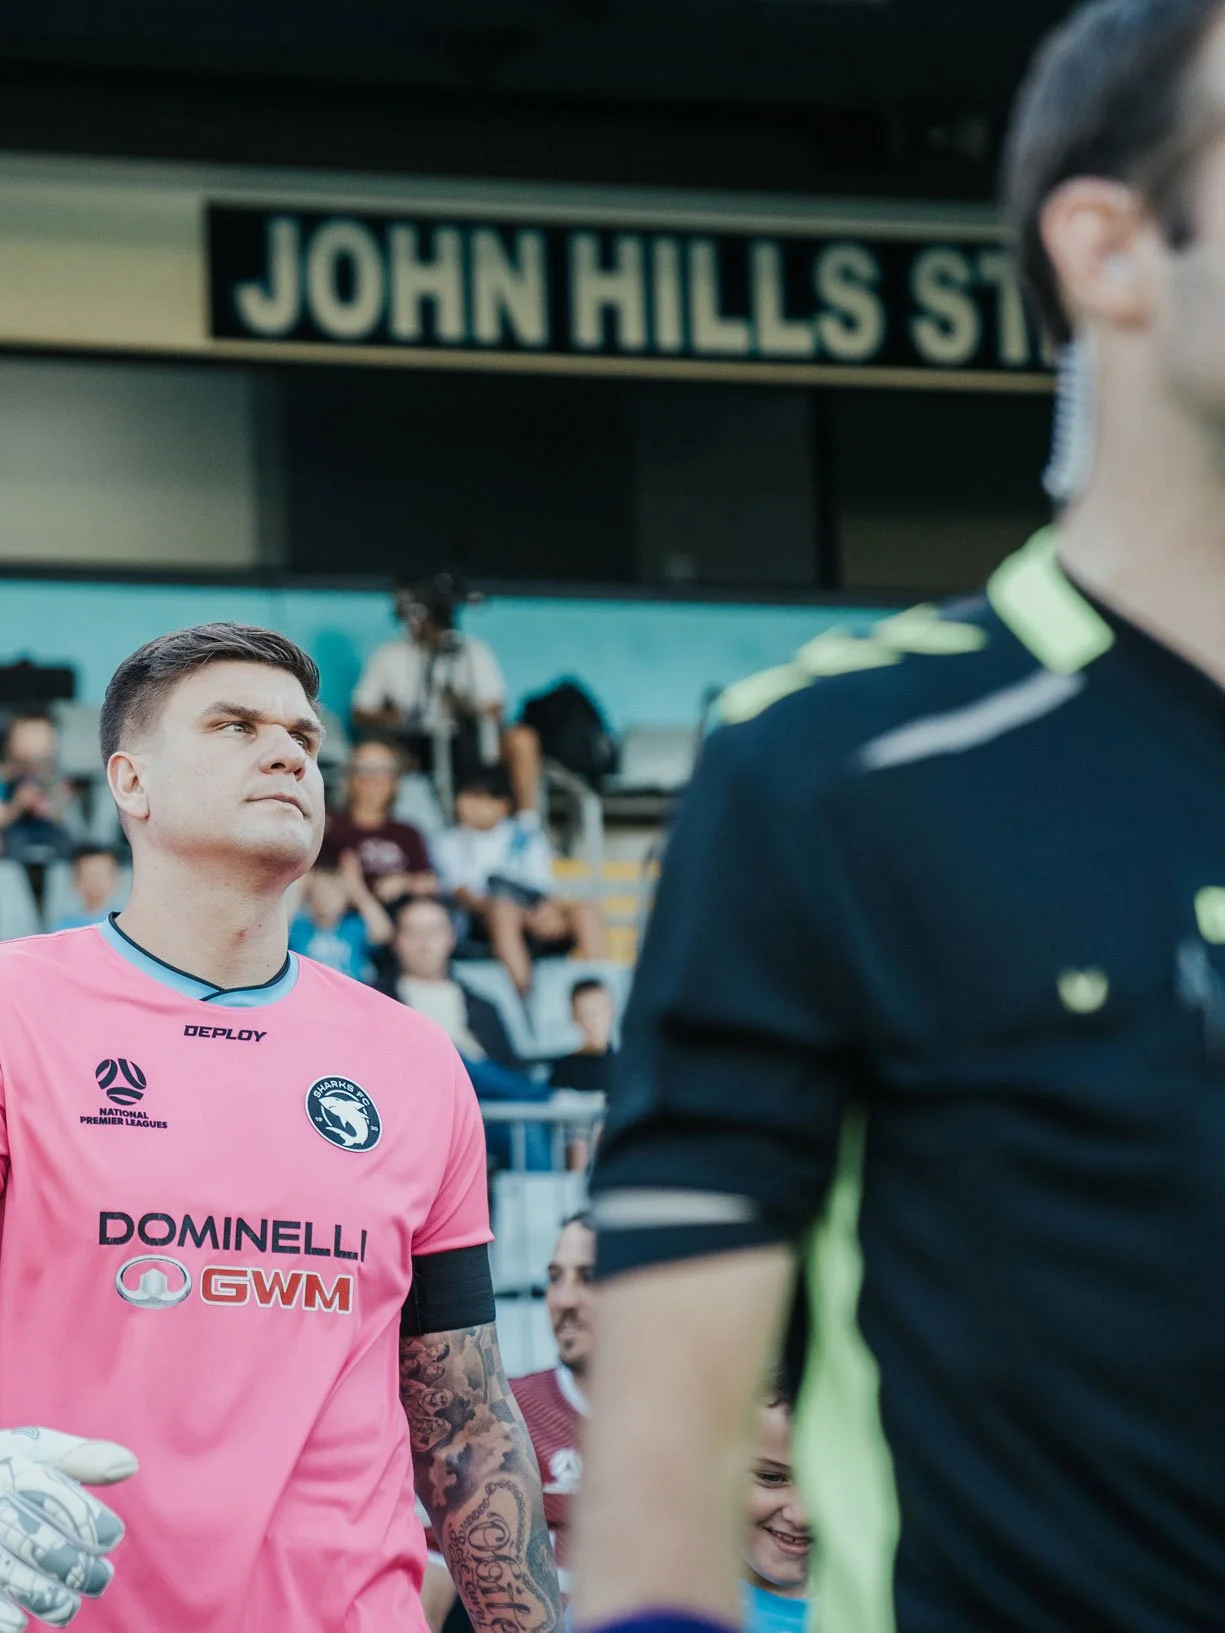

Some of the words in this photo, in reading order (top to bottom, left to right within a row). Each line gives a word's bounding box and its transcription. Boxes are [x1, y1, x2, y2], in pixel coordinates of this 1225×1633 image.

[235, 216, 547, 344] JOHN
[572, 235, 883, 360] HILLS
[911, 250, 1054, 367] ST
[184, 1025, 267, 1042] DEPLOY
[313, 1080, 354, 1098] SHARKS
[356, 1091, 371, 1107] FC
[80, 1116, 124, 1126] PREMIER
[126, 1118, 168, 1129] LEAGUES
[99, 1108, 149, 1119] NATIONAL
[99, 1211, 367, 1262] DOMINELLI
[201, 1266, 353, 1313] GWM
